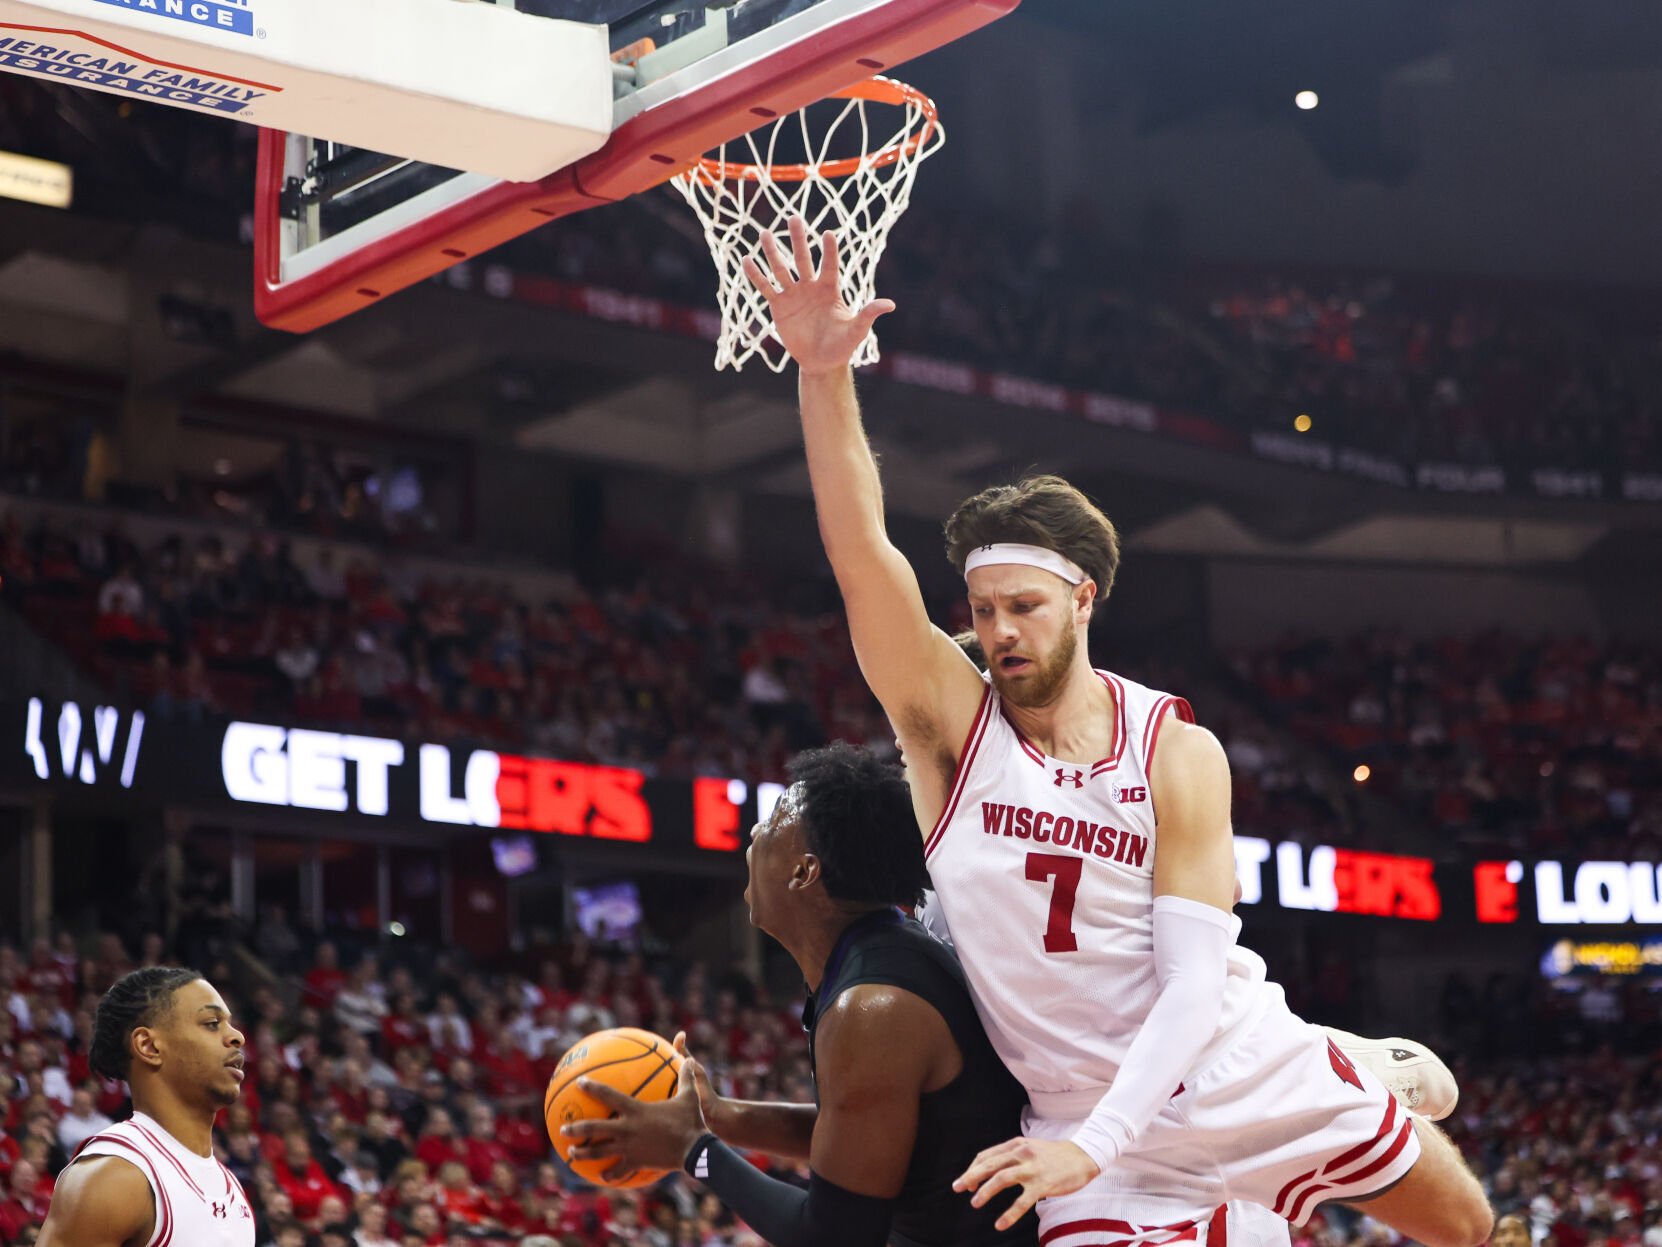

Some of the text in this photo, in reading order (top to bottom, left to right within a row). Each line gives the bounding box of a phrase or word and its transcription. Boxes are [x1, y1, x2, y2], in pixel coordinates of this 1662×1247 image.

[116, 0, 233, 27] ANCE
[143, 70, 266, 101] FAMILY
[221, 720, 404, 816] GET
[981, 802, 1148, 868] WISCONSIN
[1025, 852, 1084, 953] 7
